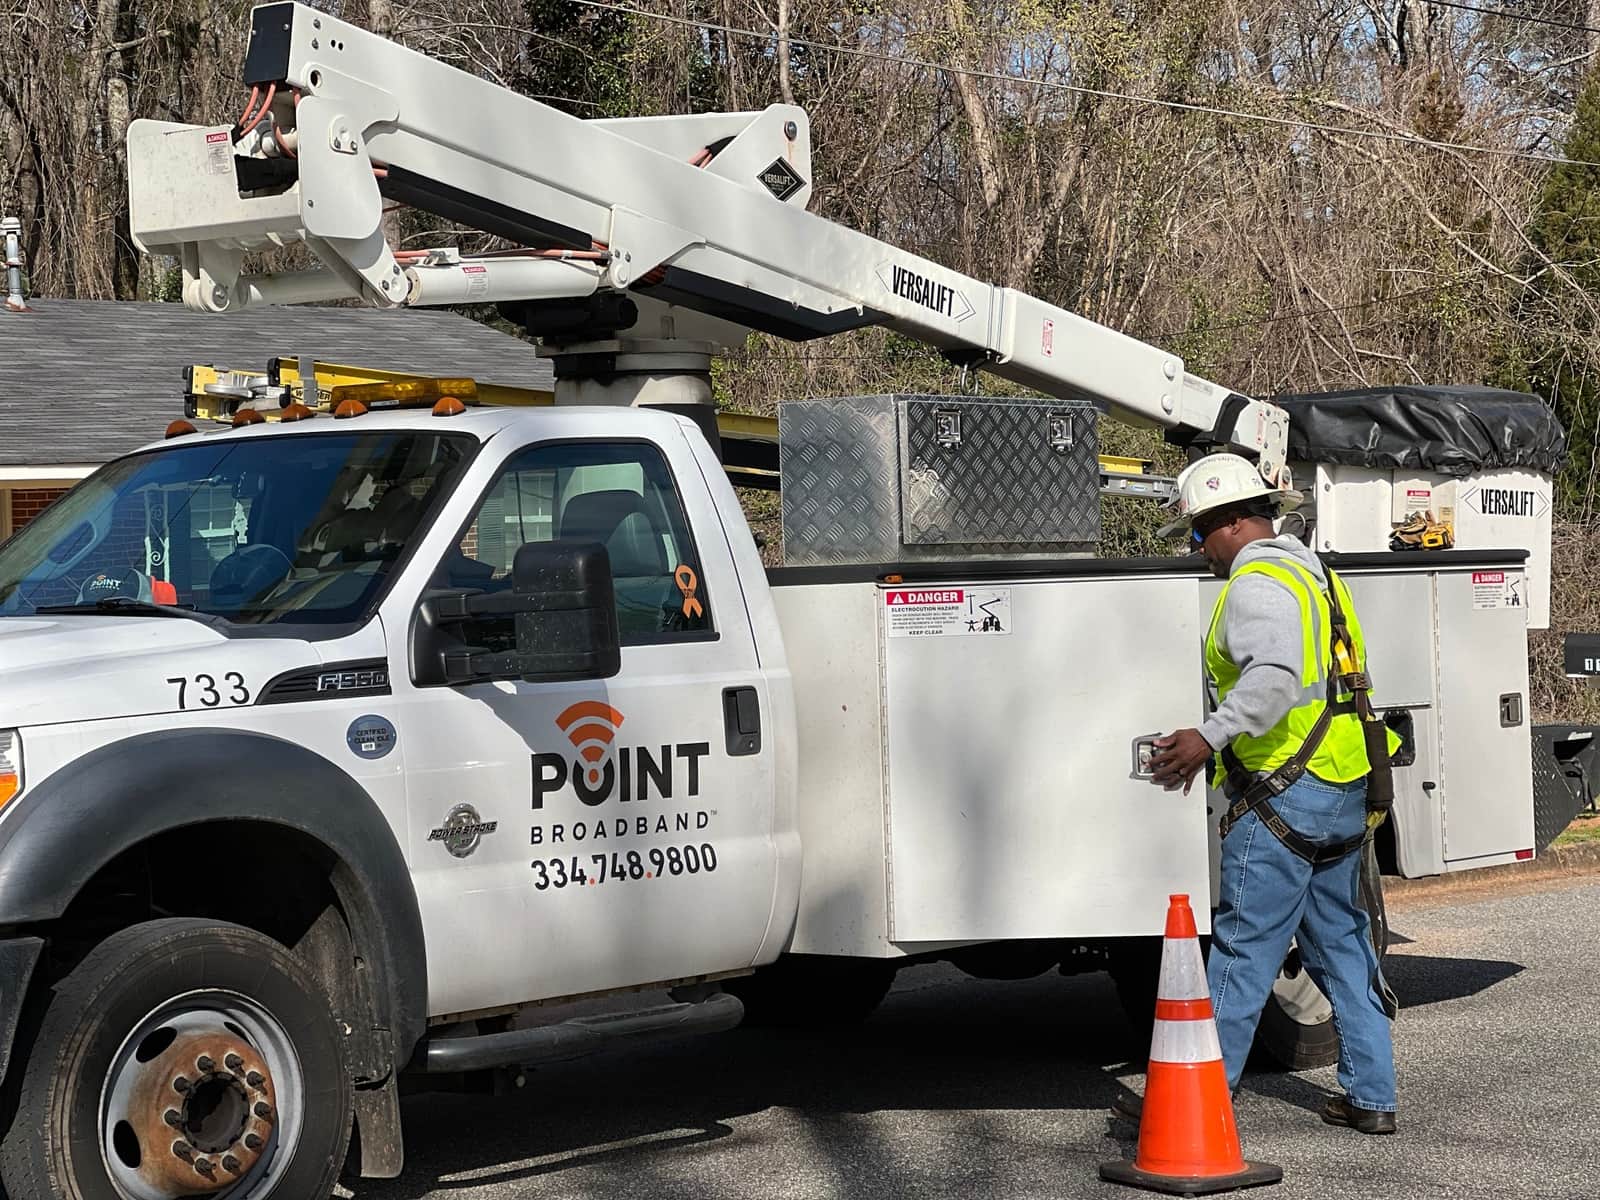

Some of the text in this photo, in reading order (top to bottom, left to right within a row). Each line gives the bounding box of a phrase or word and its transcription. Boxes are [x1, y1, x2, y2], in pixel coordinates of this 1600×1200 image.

[892, 264, 955, 317] VERSALIFT
[1481, 488, 1534, 516] VERSALIFT
[908, 592, 958, 603] DANGER
[166, 672, 250, 710] 733
[531, 742, 710, 810] POINT
[531, 811, 709, 845] BROADBAND
[531, 843, 717, 890] 334.748.9800
